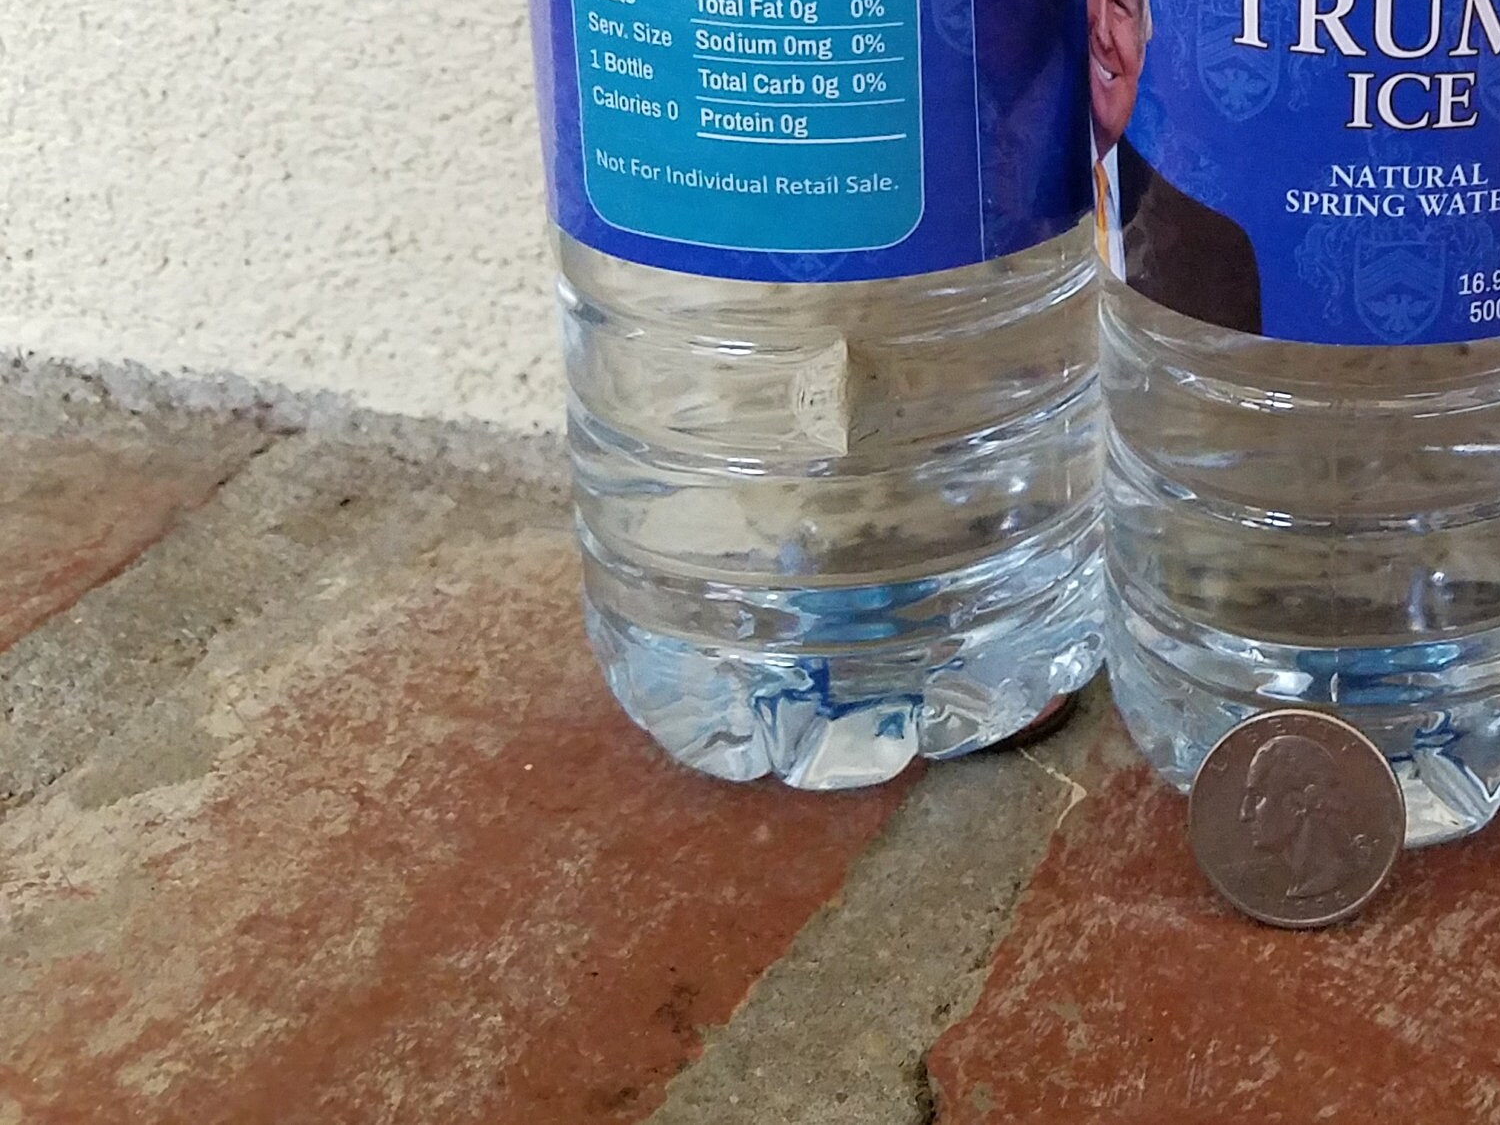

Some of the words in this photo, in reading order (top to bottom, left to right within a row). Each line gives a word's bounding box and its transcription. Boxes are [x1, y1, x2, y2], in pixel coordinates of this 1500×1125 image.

[790, 0, 818, 23] 0g
[588, 12, 628, 42] Serv.
[633, 22, 672, 47] Size
[695, 30, 776, 56] Sodium
[784, 34, 833, 60] 0mg
[851, 34, 885, 54] 0%
[590, 50, 600, 68] 1
[604, 52, 653, 80] Bottle
[698, 68, 747, 93] Total
[753, 72, 805, 95] Carb
[811, 75, 839, 99] 0g
[852, 72, 886, 93] 0%
[592, 85, 662, 119] Calories
[667, 100, 679, 120] 0
[1346, 72, 1479, 130] ICE
[700, 109, 774, 133] Protein
[780, 113, 808, 138] 0g
[596, 148, 626, 175] Not
[631, 159, 661, 181] For
[666, 167, 768, 195] Individual
[776, 176, 839, 195] Retail
[846, 175, 899, 194] Sale.
[1331, 163, 1488, 189] NATURAL
[1285, 190, 1405, 218] SPRING
